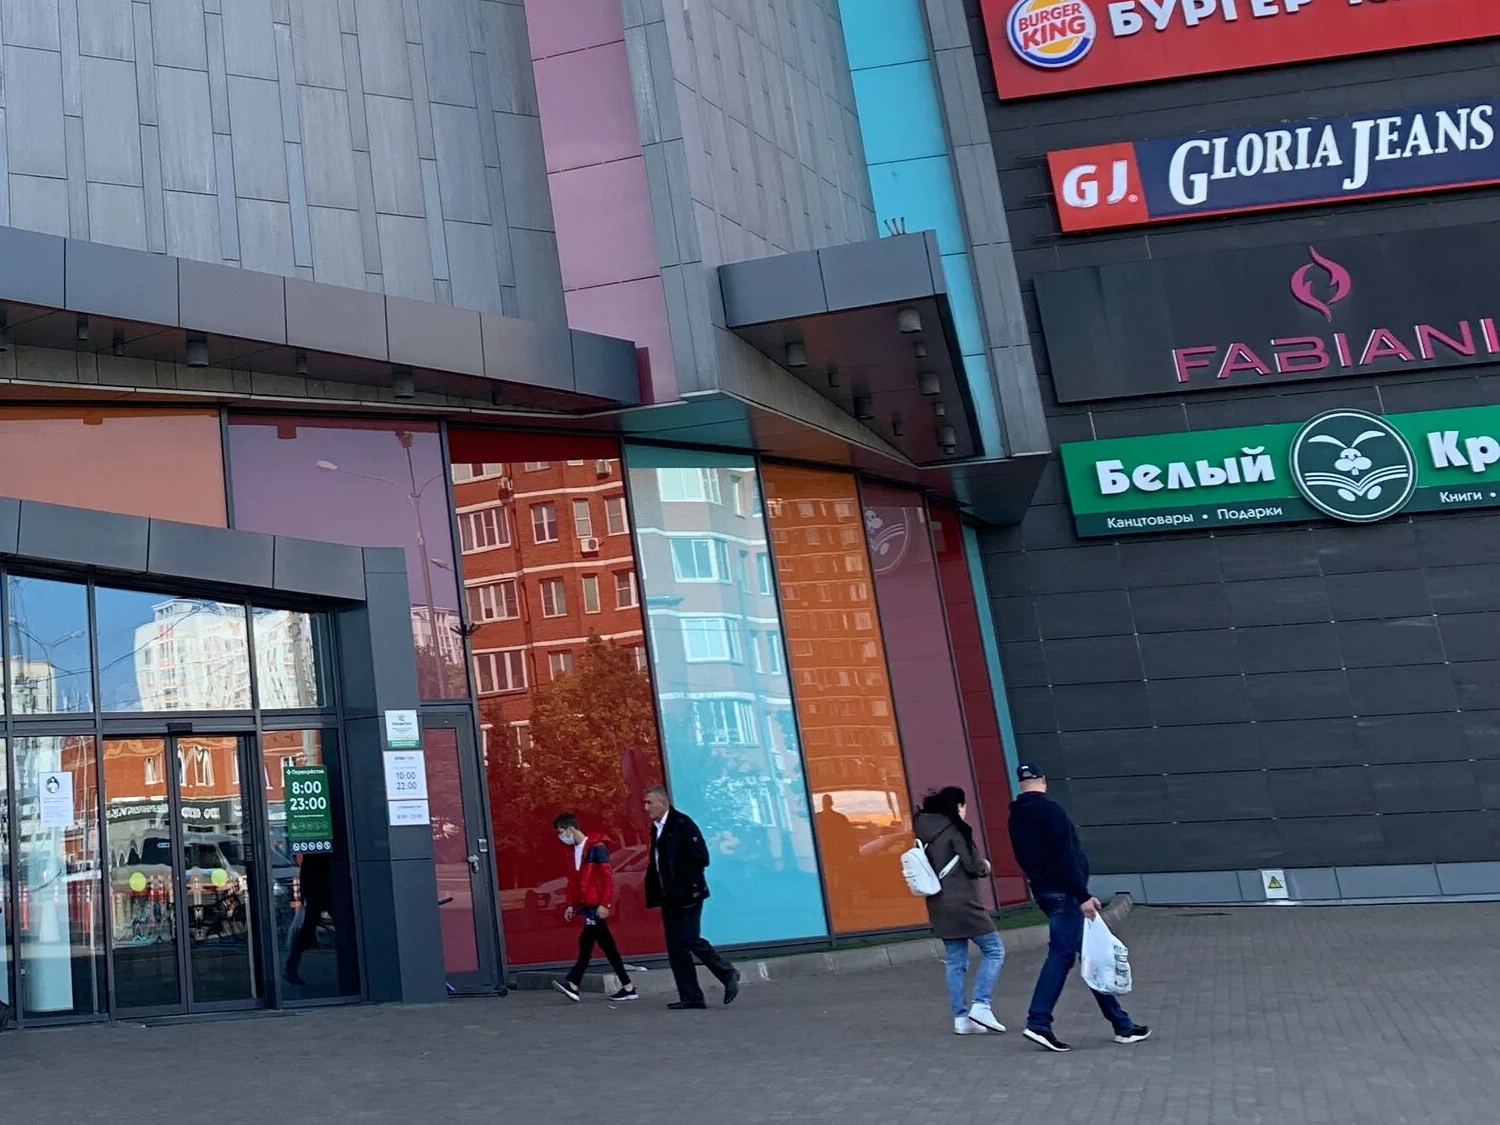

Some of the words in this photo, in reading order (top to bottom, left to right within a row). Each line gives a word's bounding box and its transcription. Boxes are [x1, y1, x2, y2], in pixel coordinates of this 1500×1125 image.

[1018, 2, 1082, 32] BURGER
[1023, 15, 1086, 50] KING
[1168, 124, 1343, 206] GLORIA
[1341, 104, 1495, 191] JEANS
[1172, 317, 1500, 384] FABIANI
[1094, 446, 1276, 495] Белый
[1107, 512, 1195, 529] Канцтовары
[1217, 506, 1283, 521] Подарки
[1440, 491, 1483, 504] Книги
[289, 796, 327, 811] 23:00
[291, 780, 322, 794] 8:00
